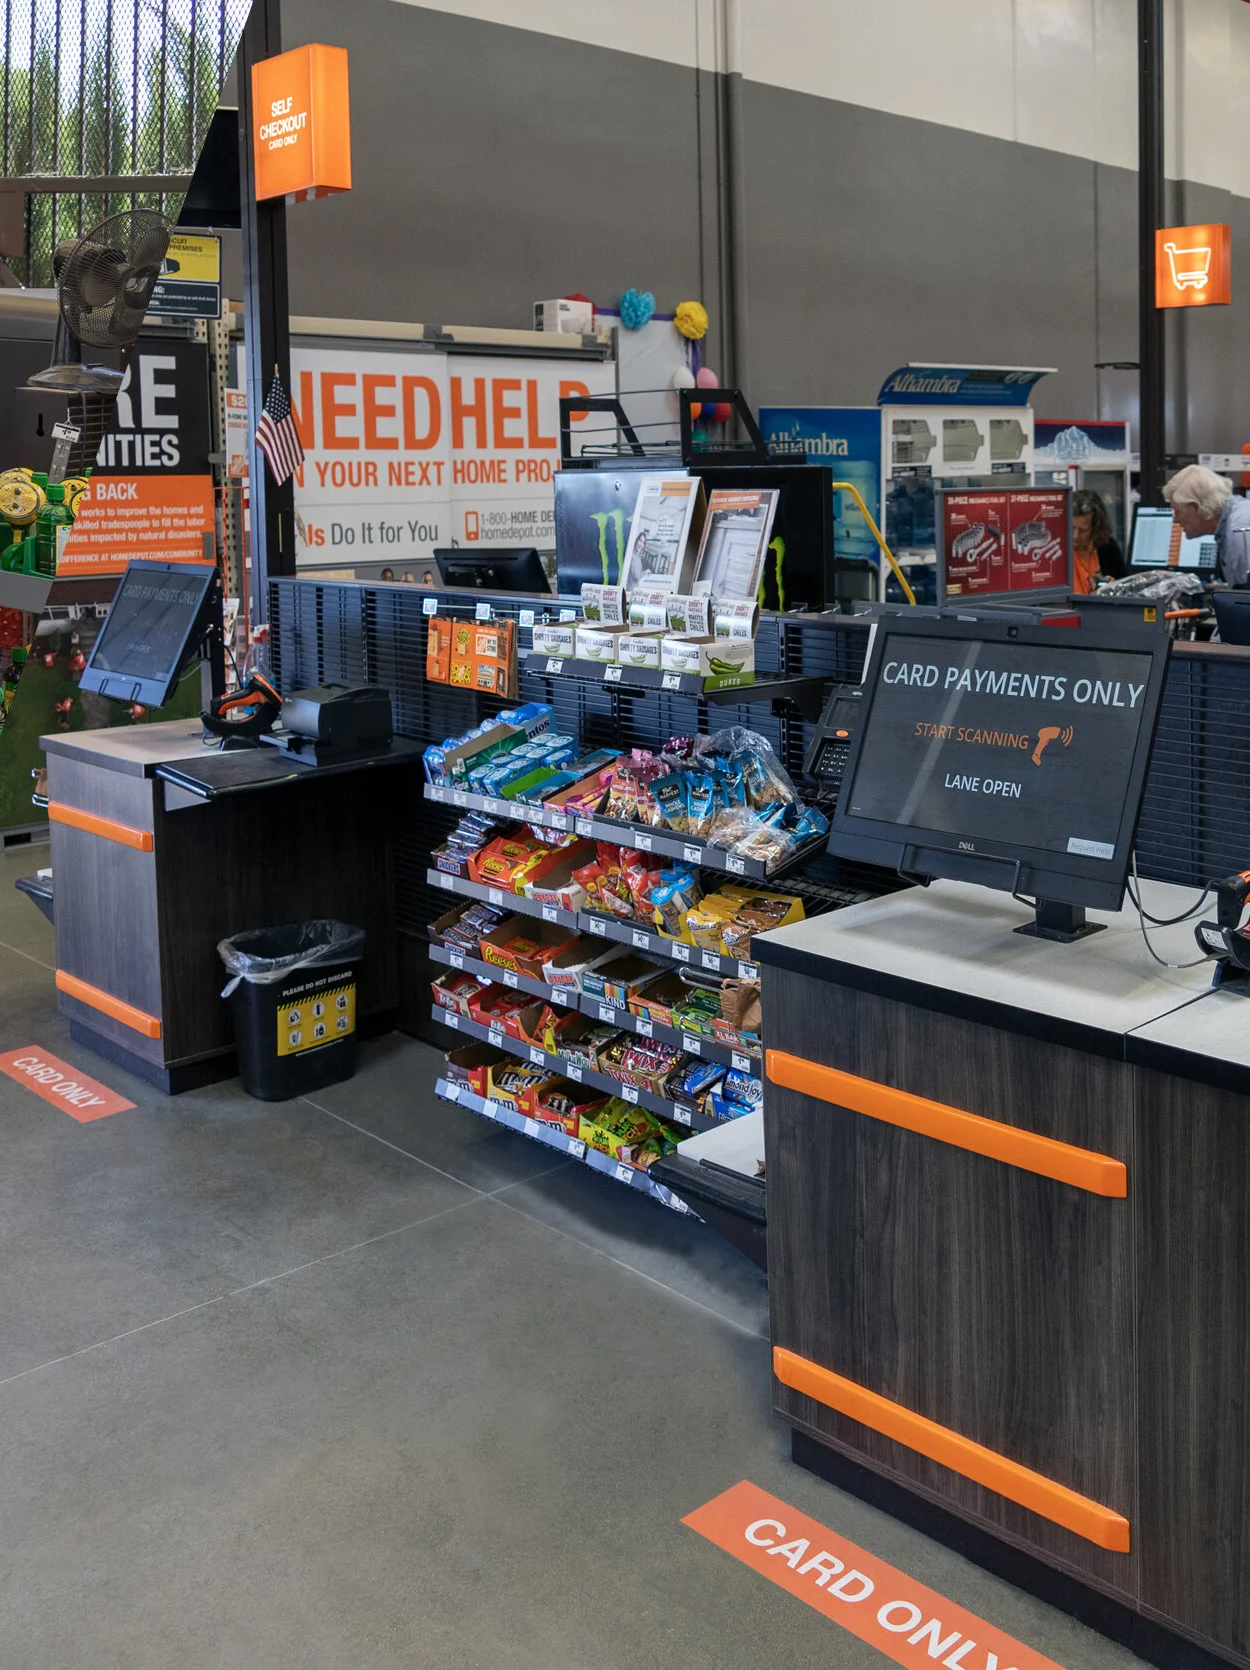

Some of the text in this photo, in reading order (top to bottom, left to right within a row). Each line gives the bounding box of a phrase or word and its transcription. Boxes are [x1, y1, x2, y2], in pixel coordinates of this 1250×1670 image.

[271, 96, 293, 118] SELF
[259, 112, 307, 141] CHECKOUT
[268, 134, 298, 150] CARD ONLY
[884, 373, 962, 394] Alhambra
[291, 371, 591, 451] NEED HELP
[315, 459, 508, 488] YOUR NEXT HOME
[96, 482, 139, 501] BACK
[81, 504, 204, 518] works to improve the homes and
[480, 510, 538, 526] 1-800-HOME
[74, 516, 206, 531] skilled tradespeople to fill the labor
[90, 532, 126, 544] impacted
[128, 532, 137, 543] by
[139, 530, 166, 541] natural
[331, 520, 439, 545] Do It for You
[480, 525, 556, 541] homedepot.com
[101, 554, 109, 562] AT
[122, 584, 200, 605] CARD PAYMENTS ONLY
[534, 632, 572, 644] SHORTY SAUSAGES
[733, 629, 746, 637] CHILES
[636, 644, 658, 654] SAUSAGES
[883, 661, 1145, 709] CARD PAYMENTS ONLY
[914, 722, 1030, 750] START SCANNING
[944, 773, 1022, 798] LANE OPEN
[664, 800, 680, 808] WHOLE
[664, 804, 685, 814] CASHEWS
[958, 841, 976, 851] DELL
[1070, 841, 1111, 858] Request Help
[438, 859, 460, 874] SNICKERS
[484, 946, 518, 971] Reese's
[282, 985, 304, 997] PLEASE
[315, 978, 326, 987] NOT
[328, 970, 352, 983] DISCARD
[605, 995, 626, 1010] KIND
[728, 1034, 740, 1044] BAR
[622, 1048, 657, 1071] TWIX
[12, 1056, 106, 1108] CARD ONLY
[605, 1066, 636, 1086] TWIX
[749, 1083, 763, 1098] Joy
[743, 1518, 876, 1604] CARD
